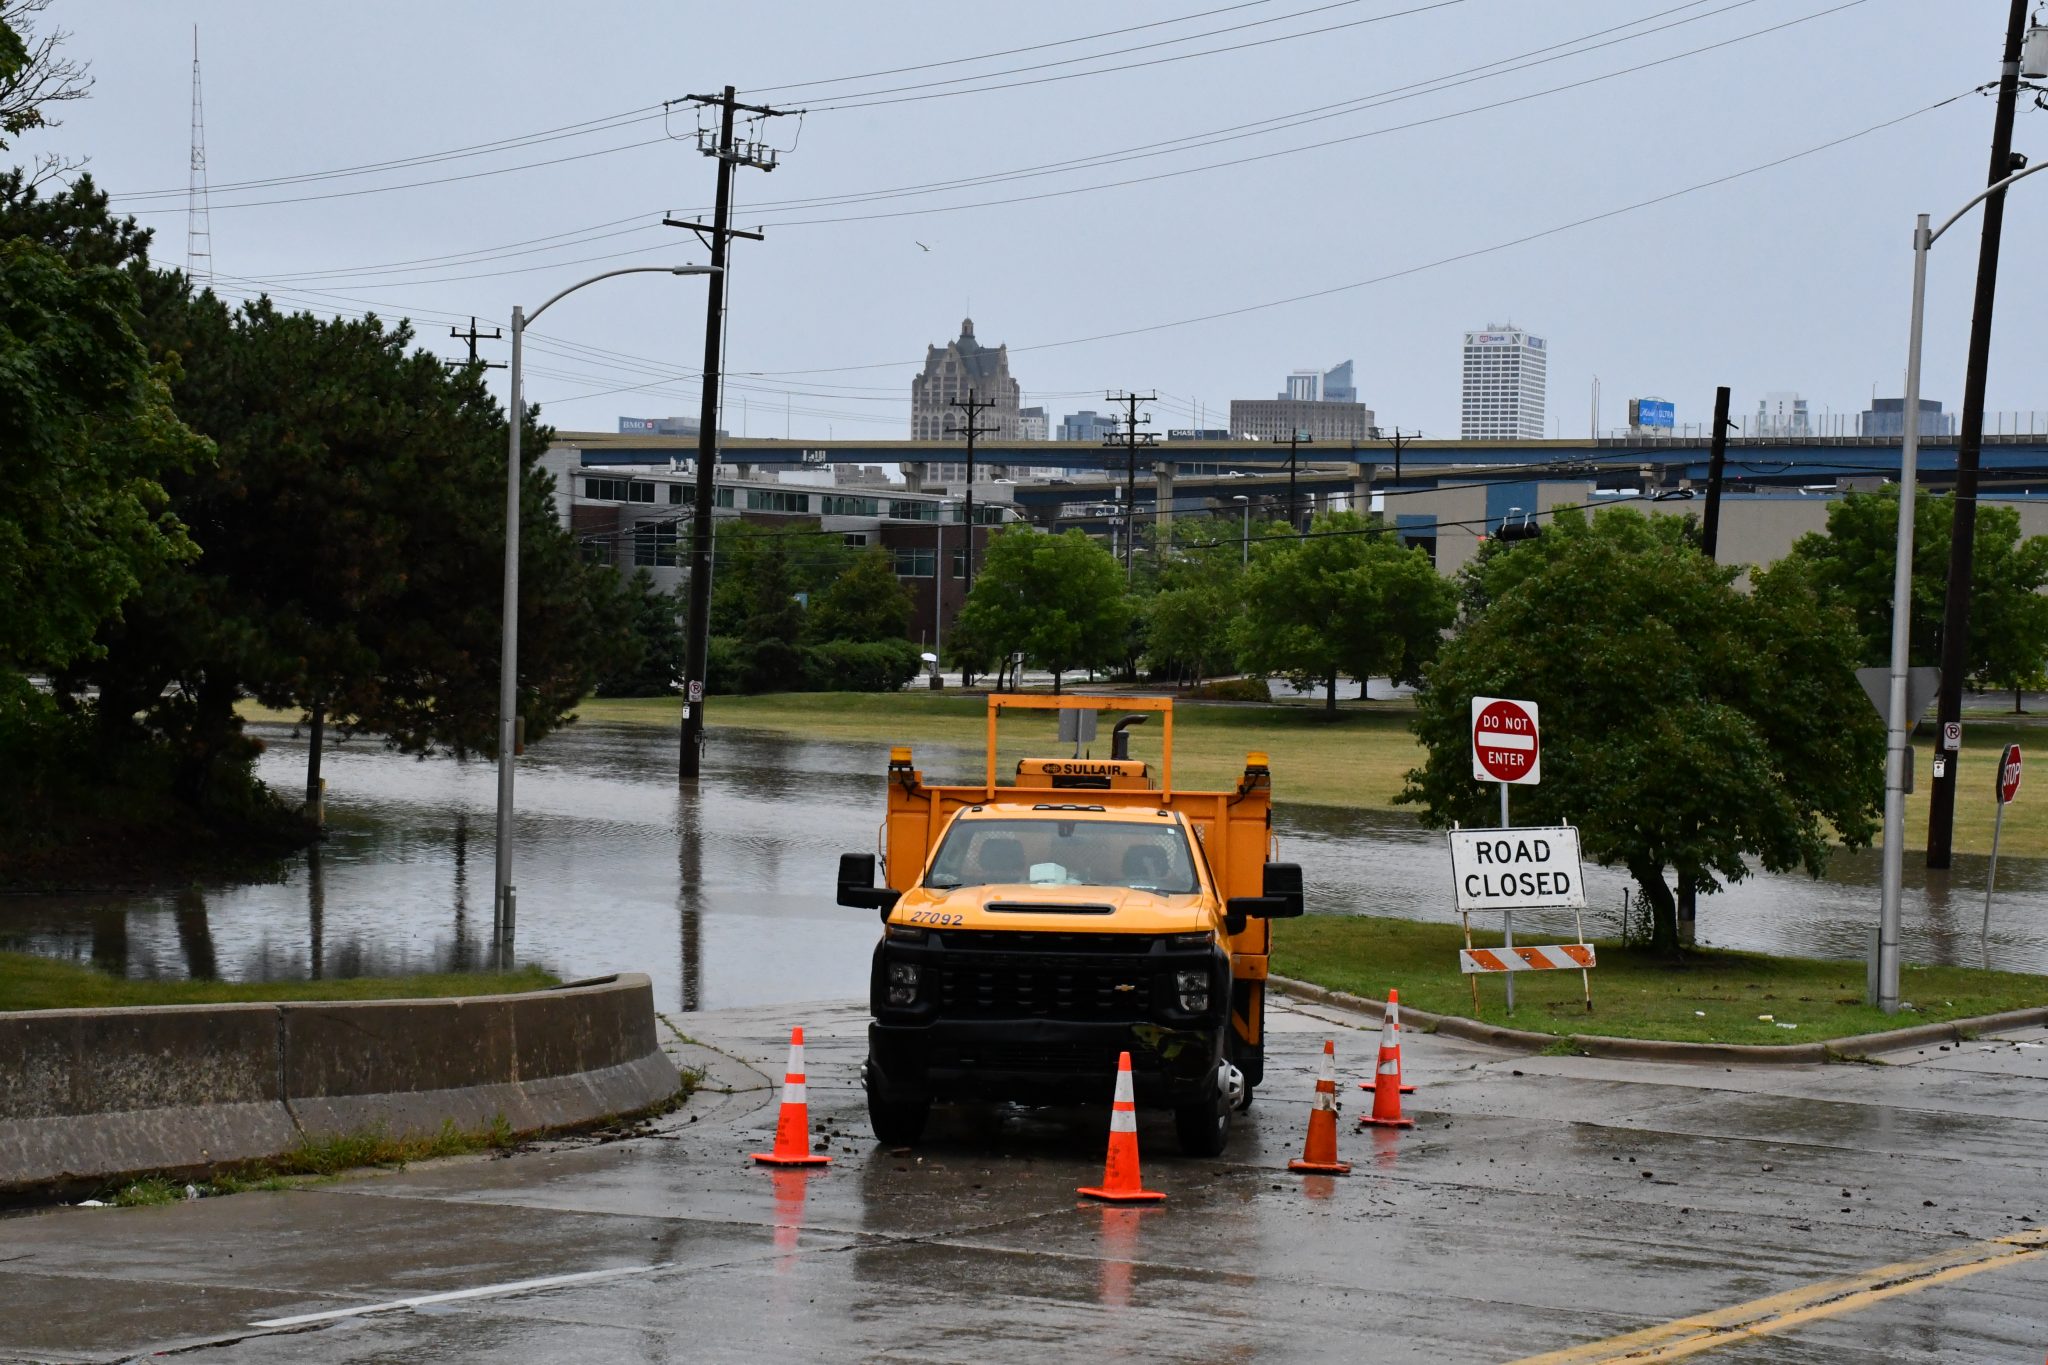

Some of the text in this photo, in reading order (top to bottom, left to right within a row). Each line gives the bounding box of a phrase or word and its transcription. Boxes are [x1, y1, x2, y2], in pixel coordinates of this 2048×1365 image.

[623, 421, 645, 429] BMO
[1483, 714, 1528, 731] DO NOT
[1488, 751, 1525, 767] ENTER
[1063, 763, 1121, 776] SULLAIR
[2003, 762, 2021, 787] STOP
[1476, 839, 1551, 865] ROAD
[1465, 872, 1571, 898] CLOSED
[910, 911, 963, 926] 27092
